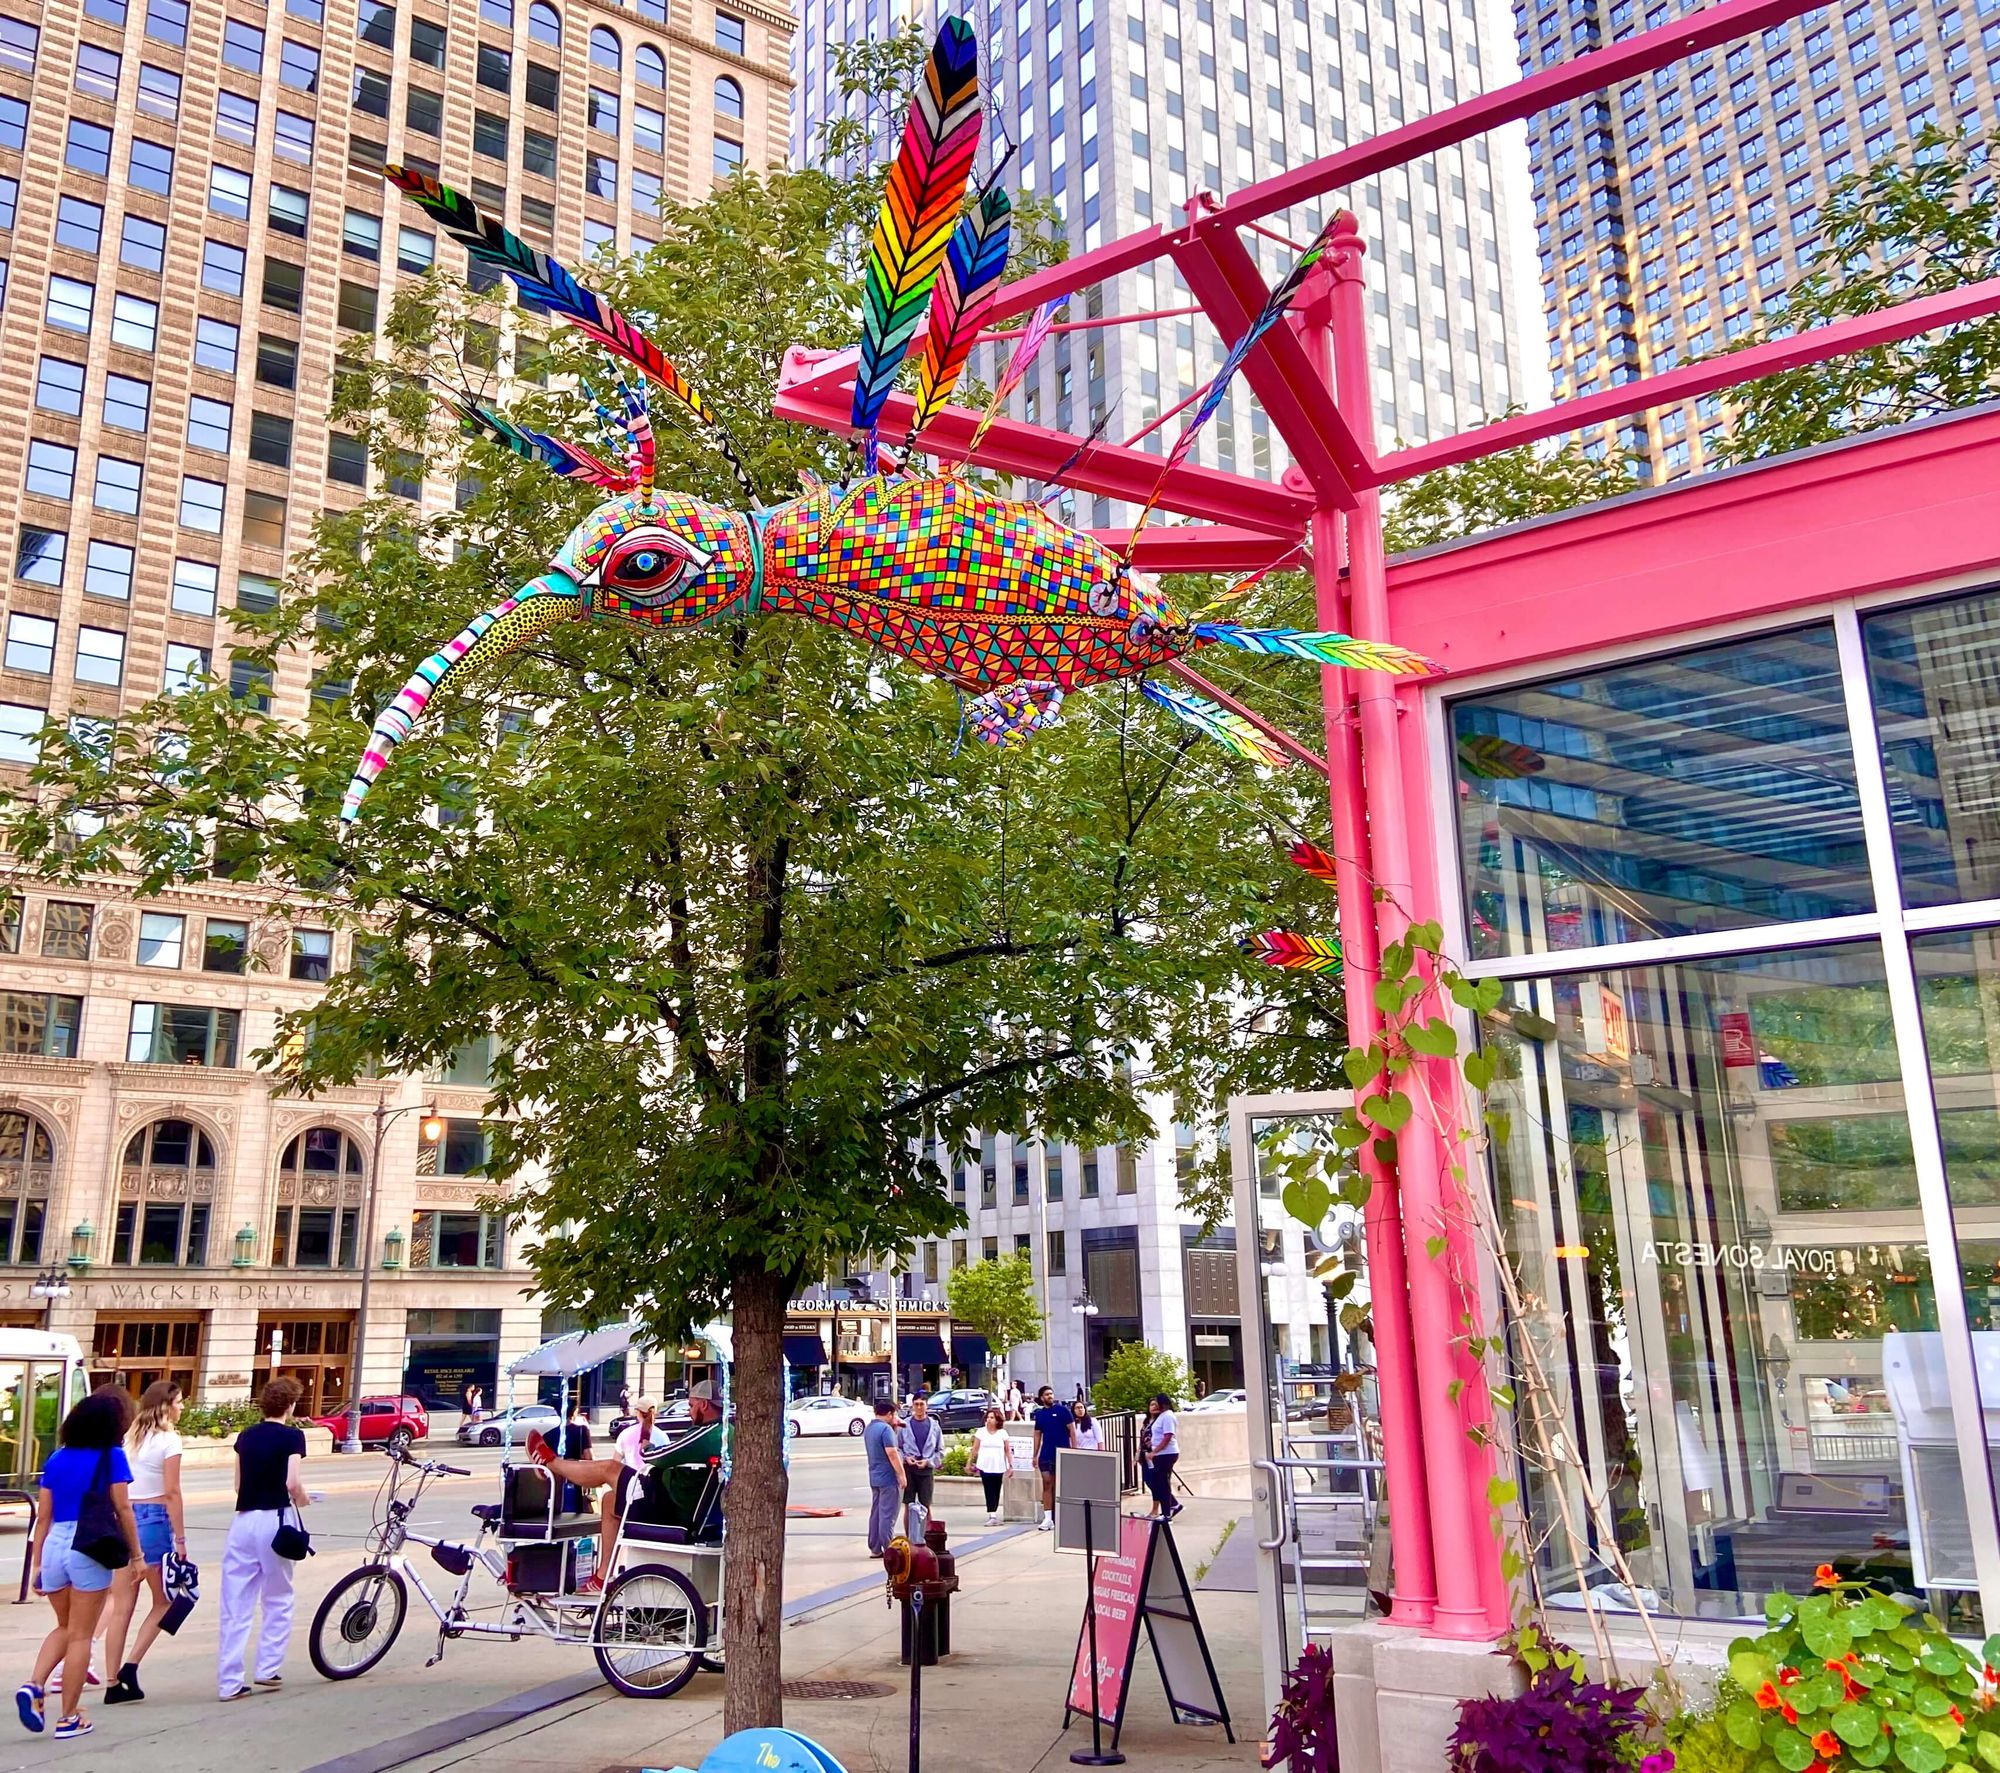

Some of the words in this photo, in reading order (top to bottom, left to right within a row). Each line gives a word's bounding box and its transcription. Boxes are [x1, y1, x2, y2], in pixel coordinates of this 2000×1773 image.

[1602, 996, 1626, 1053] EXIT
[111, 1284, 221, 1301] WACKER
[238, 1284, 314, 1300] DRIVE
